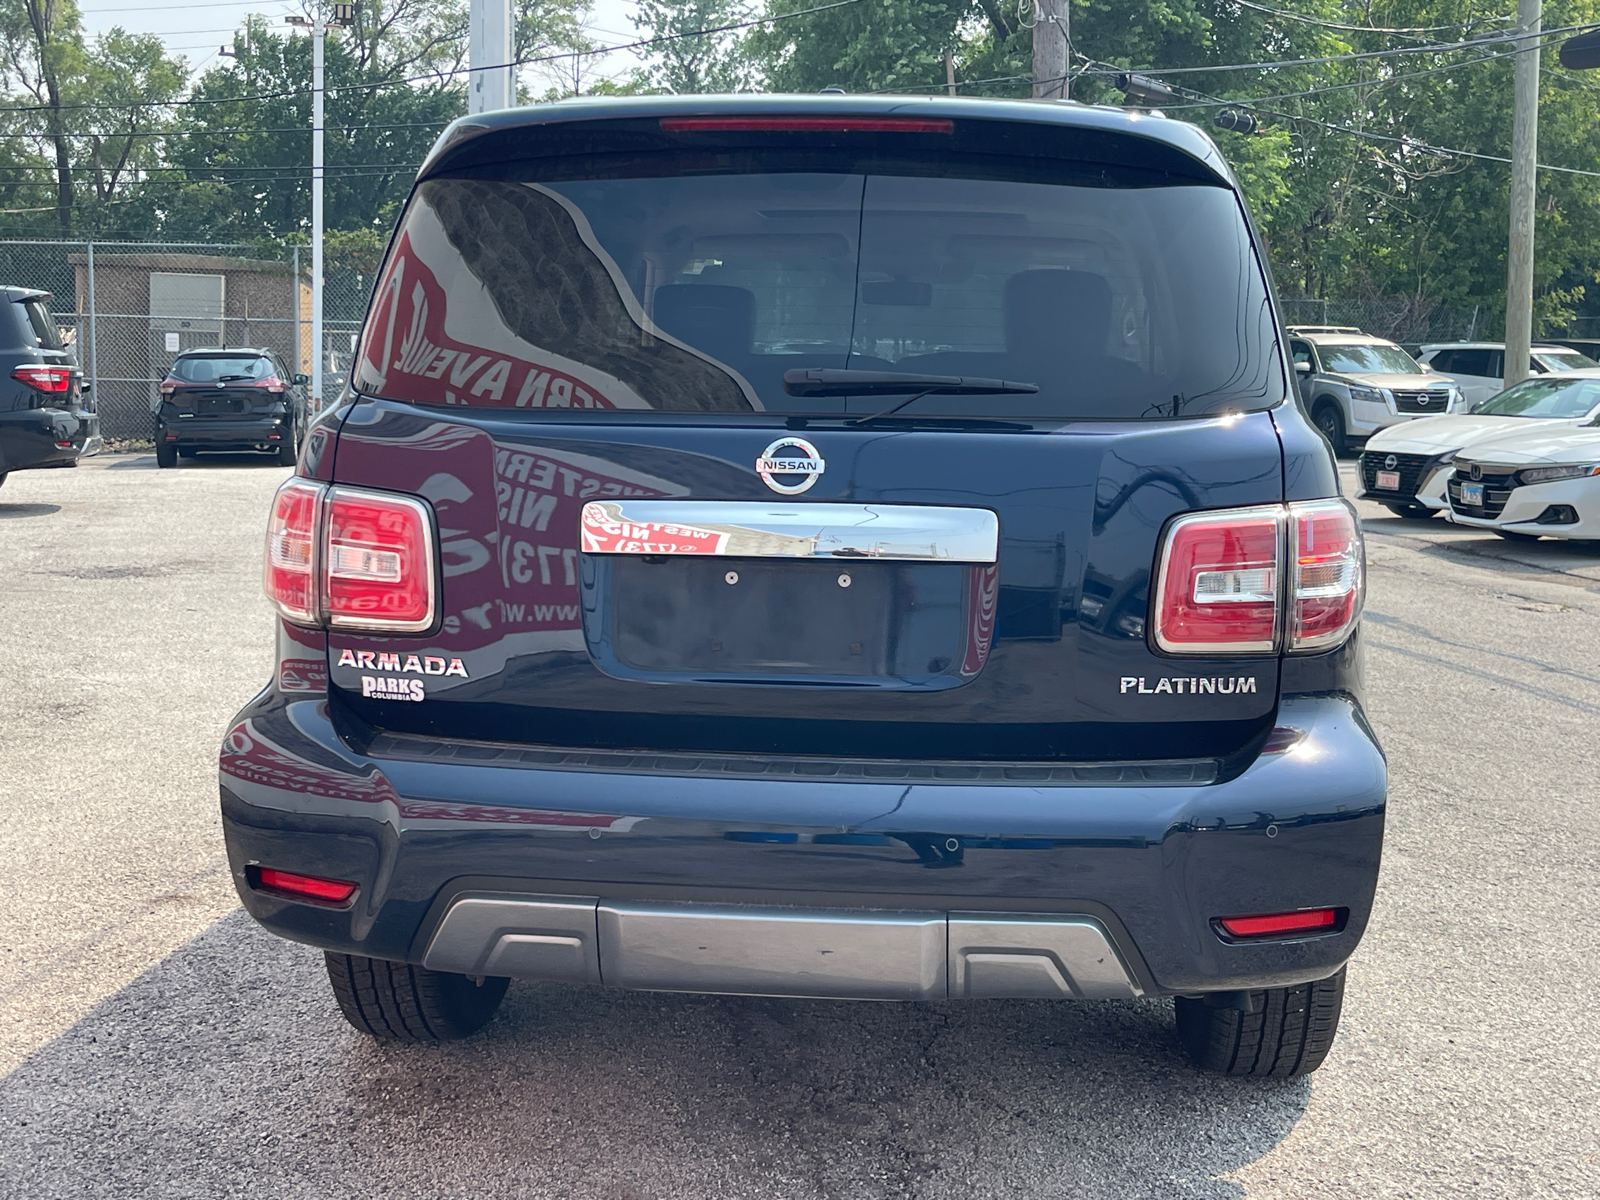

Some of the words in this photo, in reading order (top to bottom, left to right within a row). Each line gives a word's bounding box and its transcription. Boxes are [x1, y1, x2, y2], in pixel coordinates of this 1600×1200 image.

[763, 461, 817, 471] NISSAN
[338, 649, 469, 678] ARMADA
[361, 676, 425, 702] PARKS
[1120, 677, 1257, 694] PLATINUM
[371, 692, 411, 701] COLUMBIA
